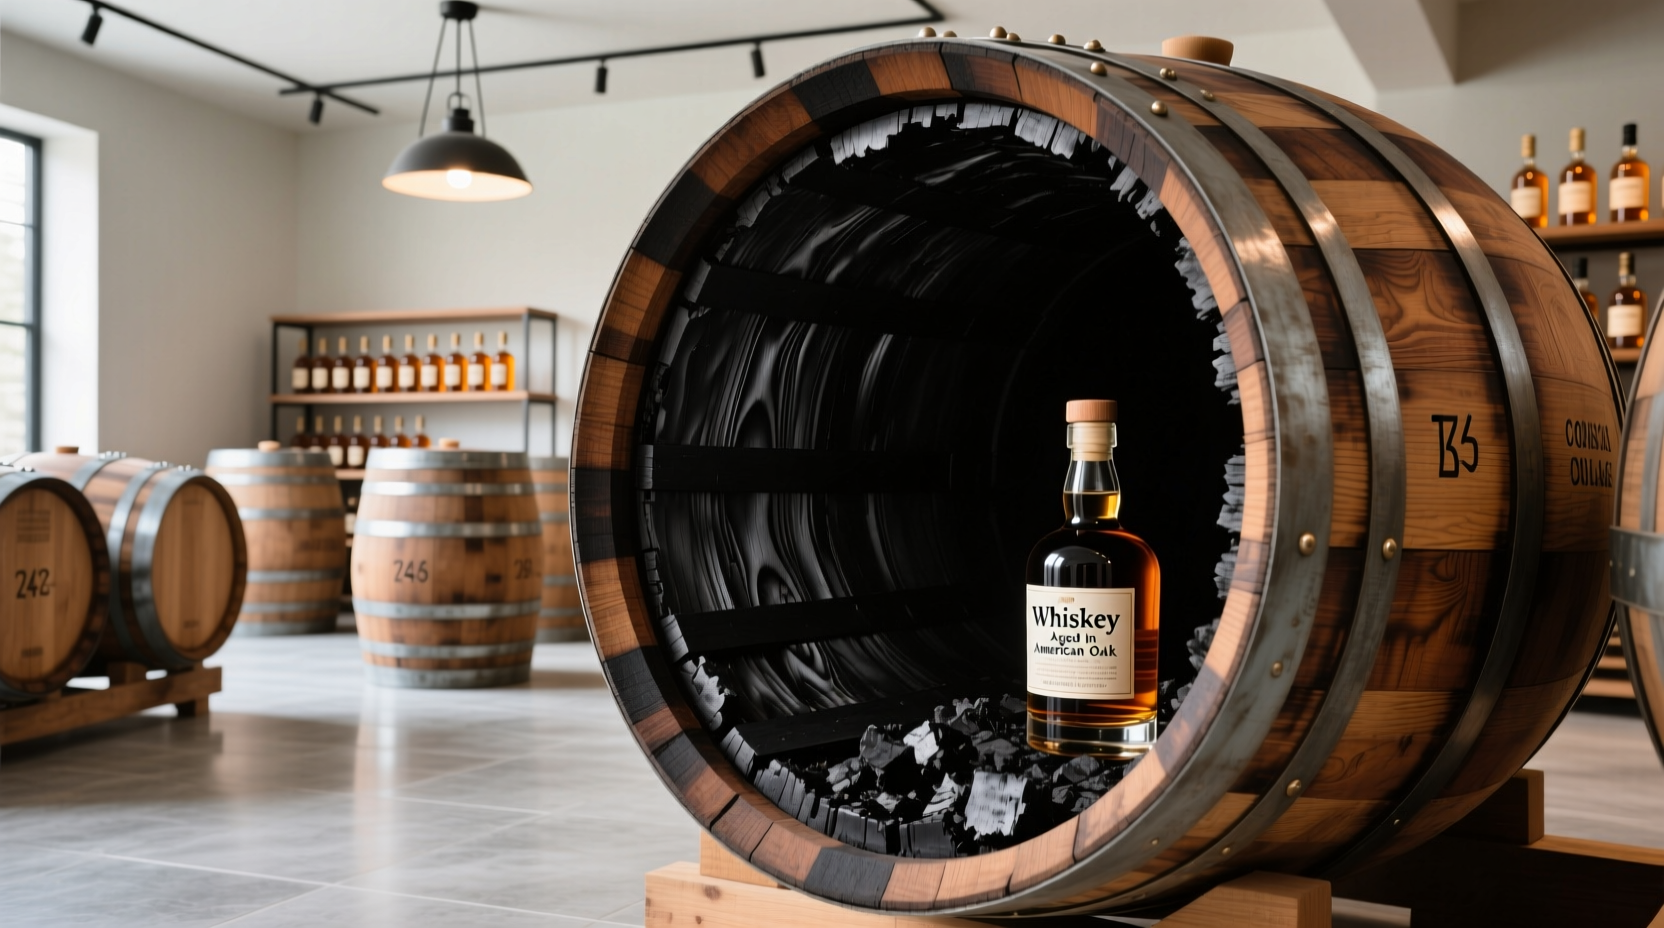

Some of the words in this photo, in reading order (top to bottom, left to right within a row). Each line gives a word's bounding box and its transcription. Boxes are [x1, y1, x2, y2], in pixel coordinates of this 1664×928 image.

[15, 567, 51, 599] 242
[393, 558, 429, 583] 246
[1032, 605, 1120, 635] Whiskey
[1033, 642, 1084, 657] American
